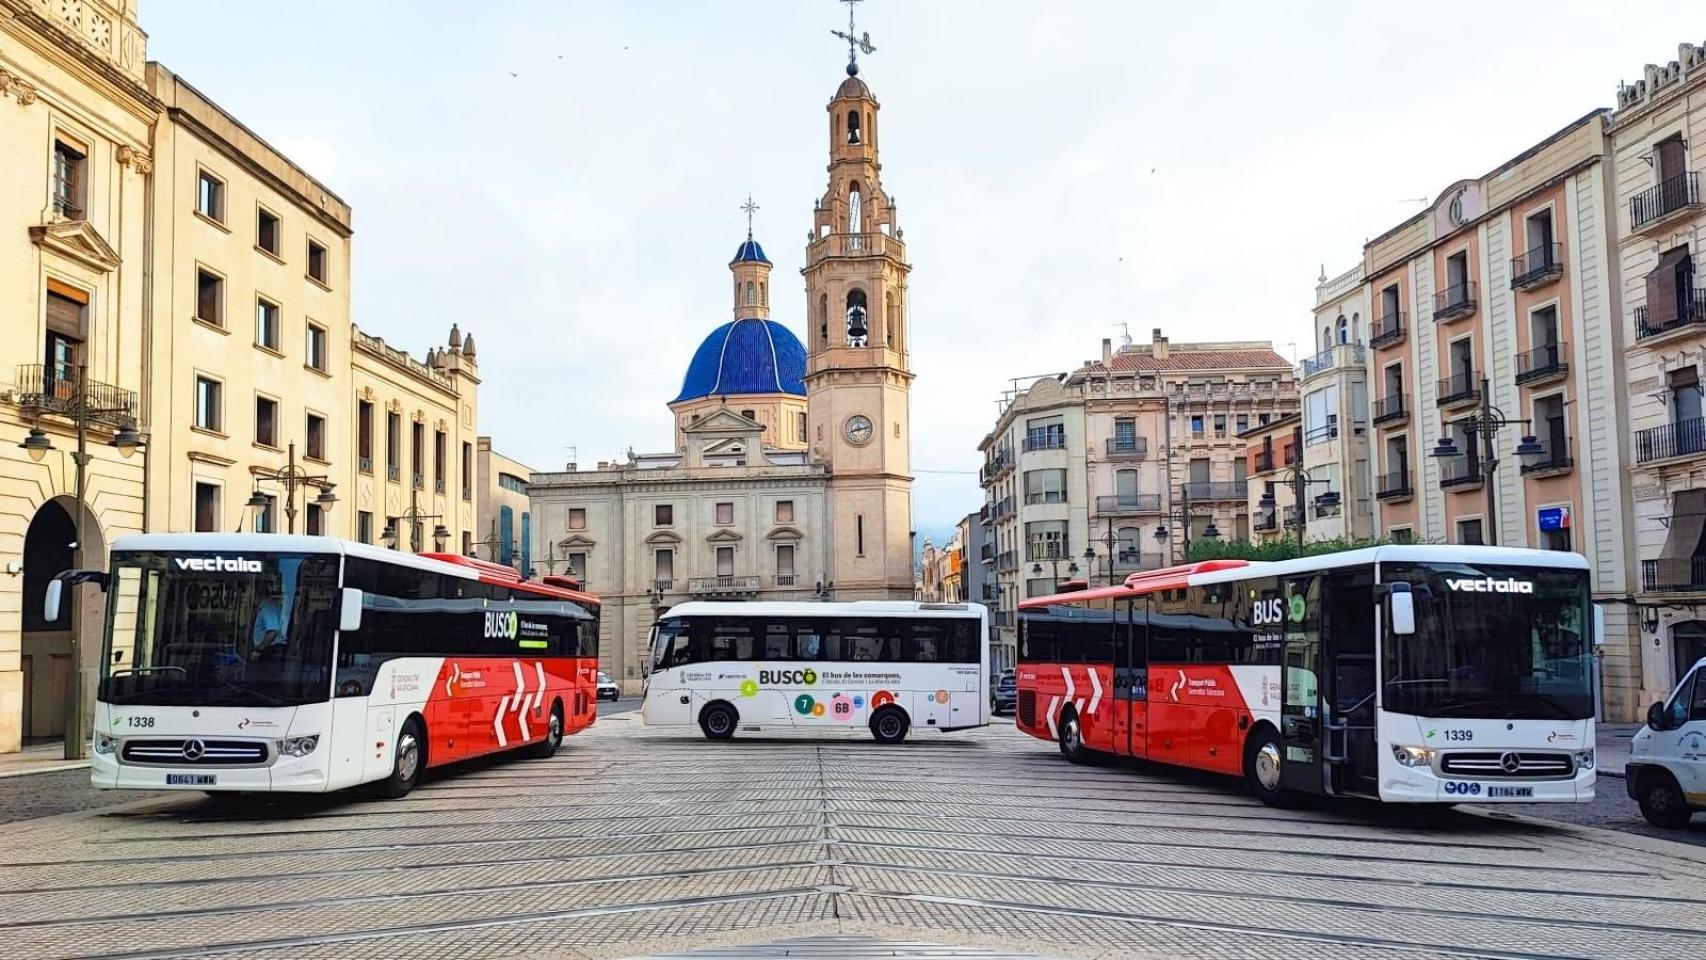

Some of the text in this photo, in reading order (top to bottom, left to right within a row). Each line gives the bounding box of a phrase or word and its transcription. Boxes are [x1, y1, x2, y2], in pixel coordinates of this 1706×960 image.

[175, 556, 262, 572] vectalia
[1446, 577, 1533, 594] vectalia
[801, 699, 808, 709] 7
[835, 703, 849, 713] 6B
[128, 717, 155, 728] 1338
[1444, 730, 1473, 741] 1339
